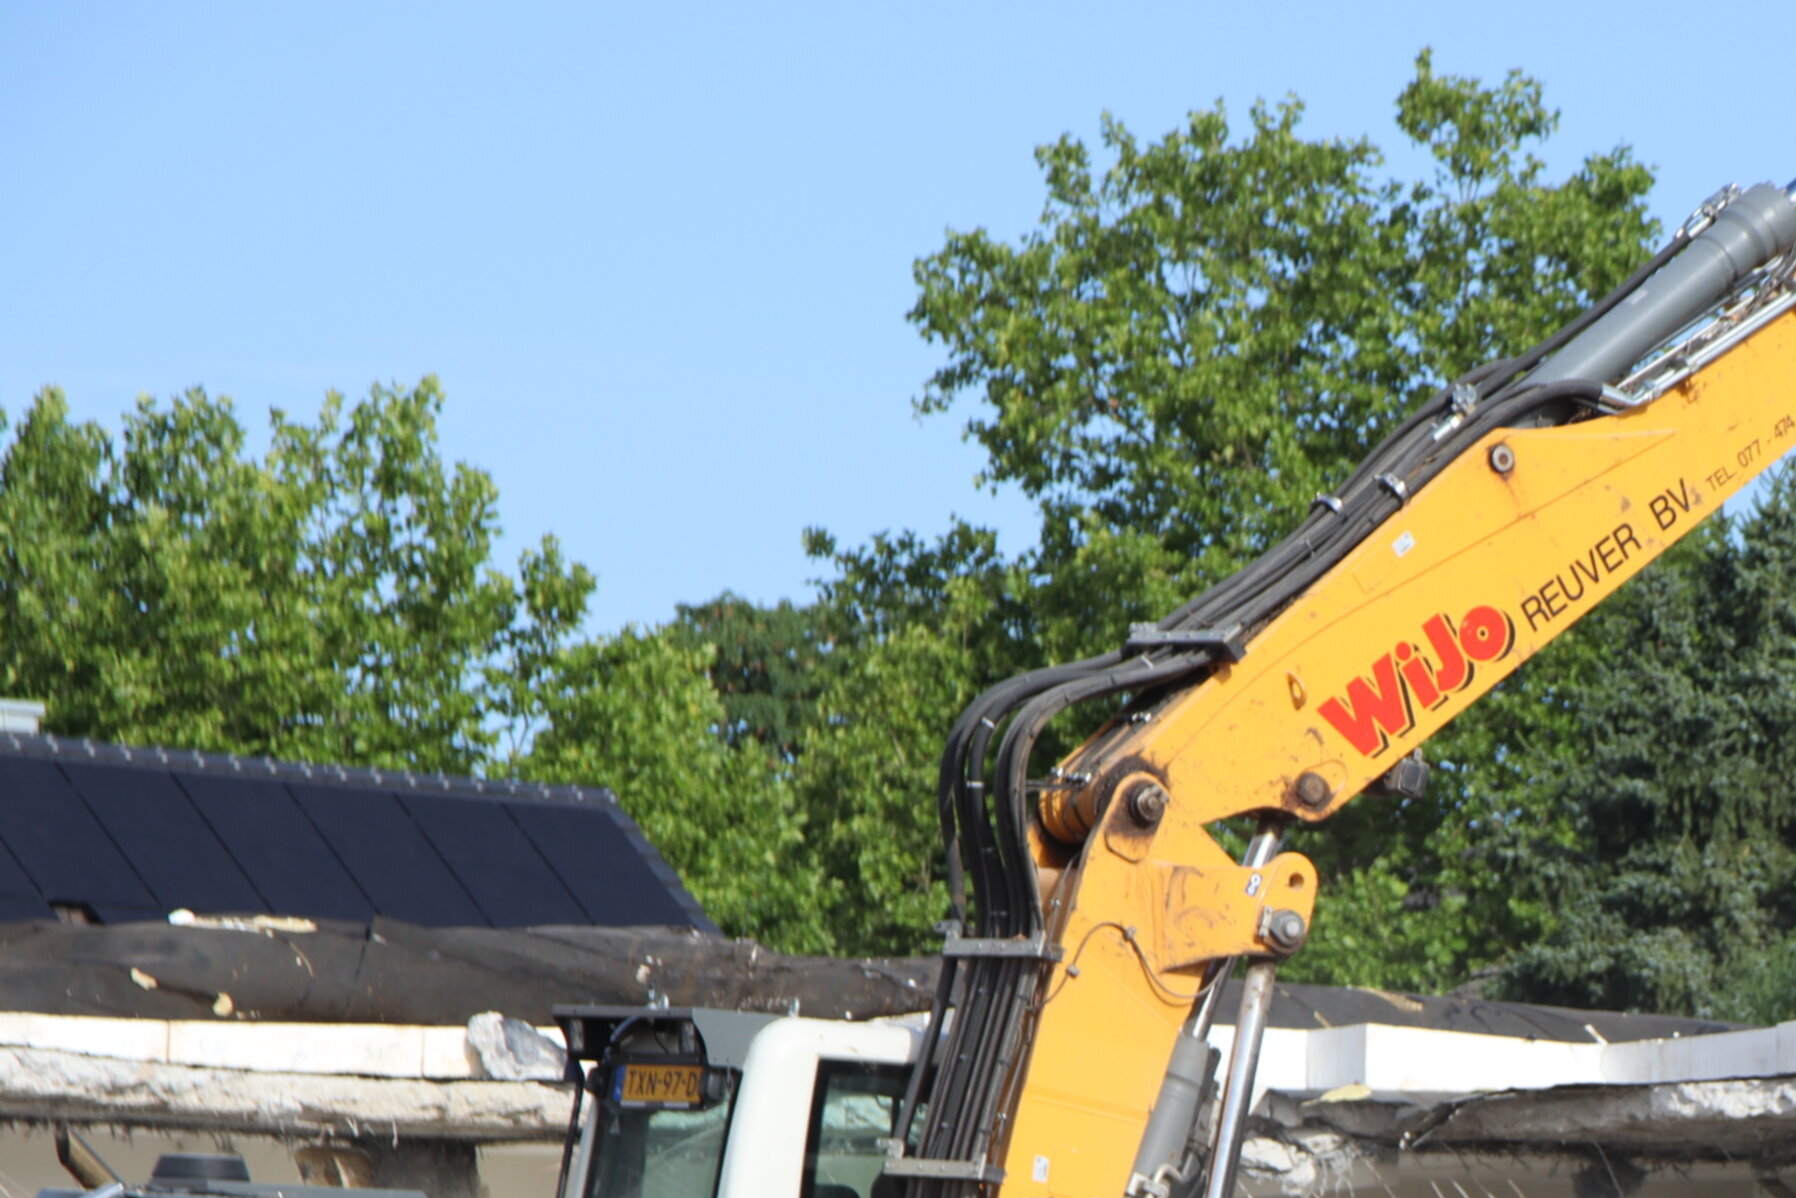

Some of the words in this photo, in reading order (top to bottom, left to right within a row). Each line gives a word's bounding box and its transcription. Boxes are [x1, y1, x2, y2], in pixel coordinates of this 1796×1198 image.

[1317, 605, 1515, 758] WiJo
[1519, 522, 1642, 632] REUVER
[1648, 478, 1691, 531] BV
[1736, 438, 1762, 469] 077
[1773, 413, 1796, 439] 474
[627, 1068, 698, 1098] TXN-97-D
